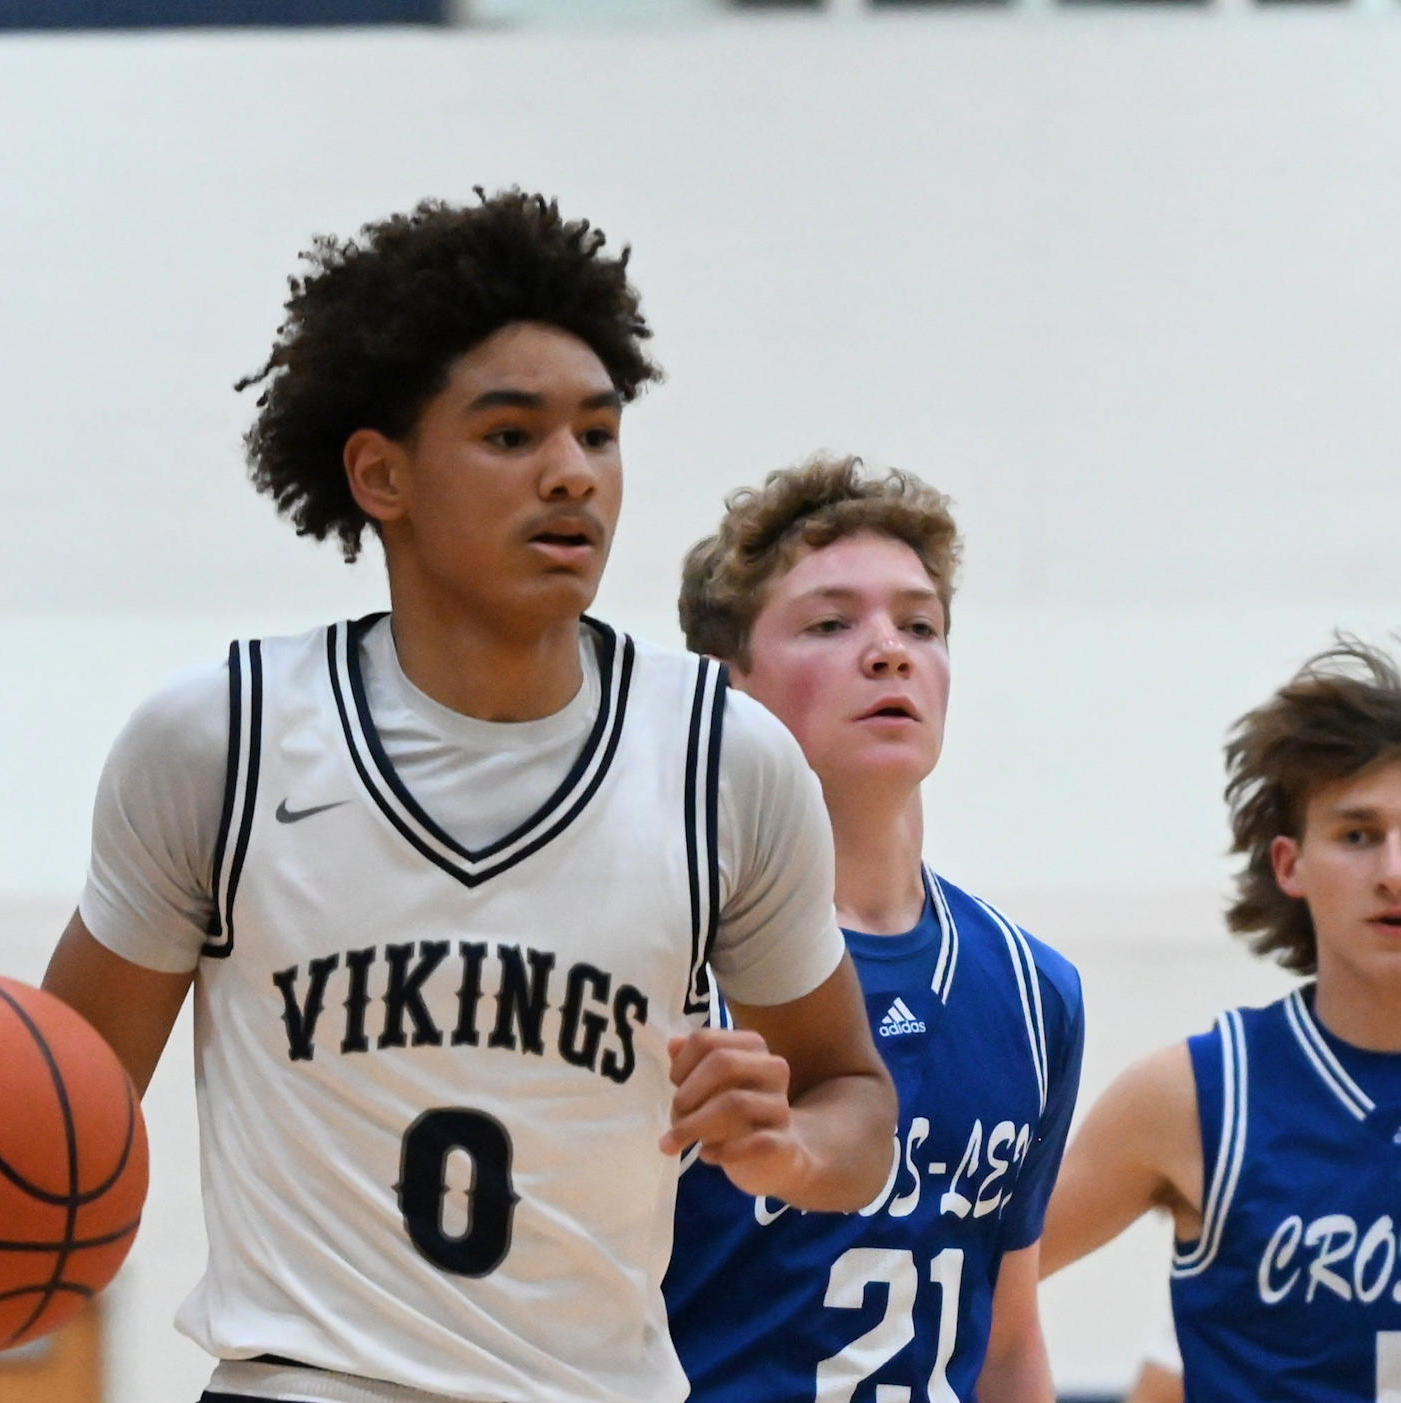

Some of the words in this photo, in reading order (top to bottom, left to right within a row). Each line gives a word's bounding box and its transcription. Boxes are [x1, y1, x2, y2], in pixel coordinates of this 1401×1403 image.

[273, 940, 648, 1084] VIKINGS
[879, 1020, 926, 1037] adidas
[393, 1106, 522, 1278] 0
